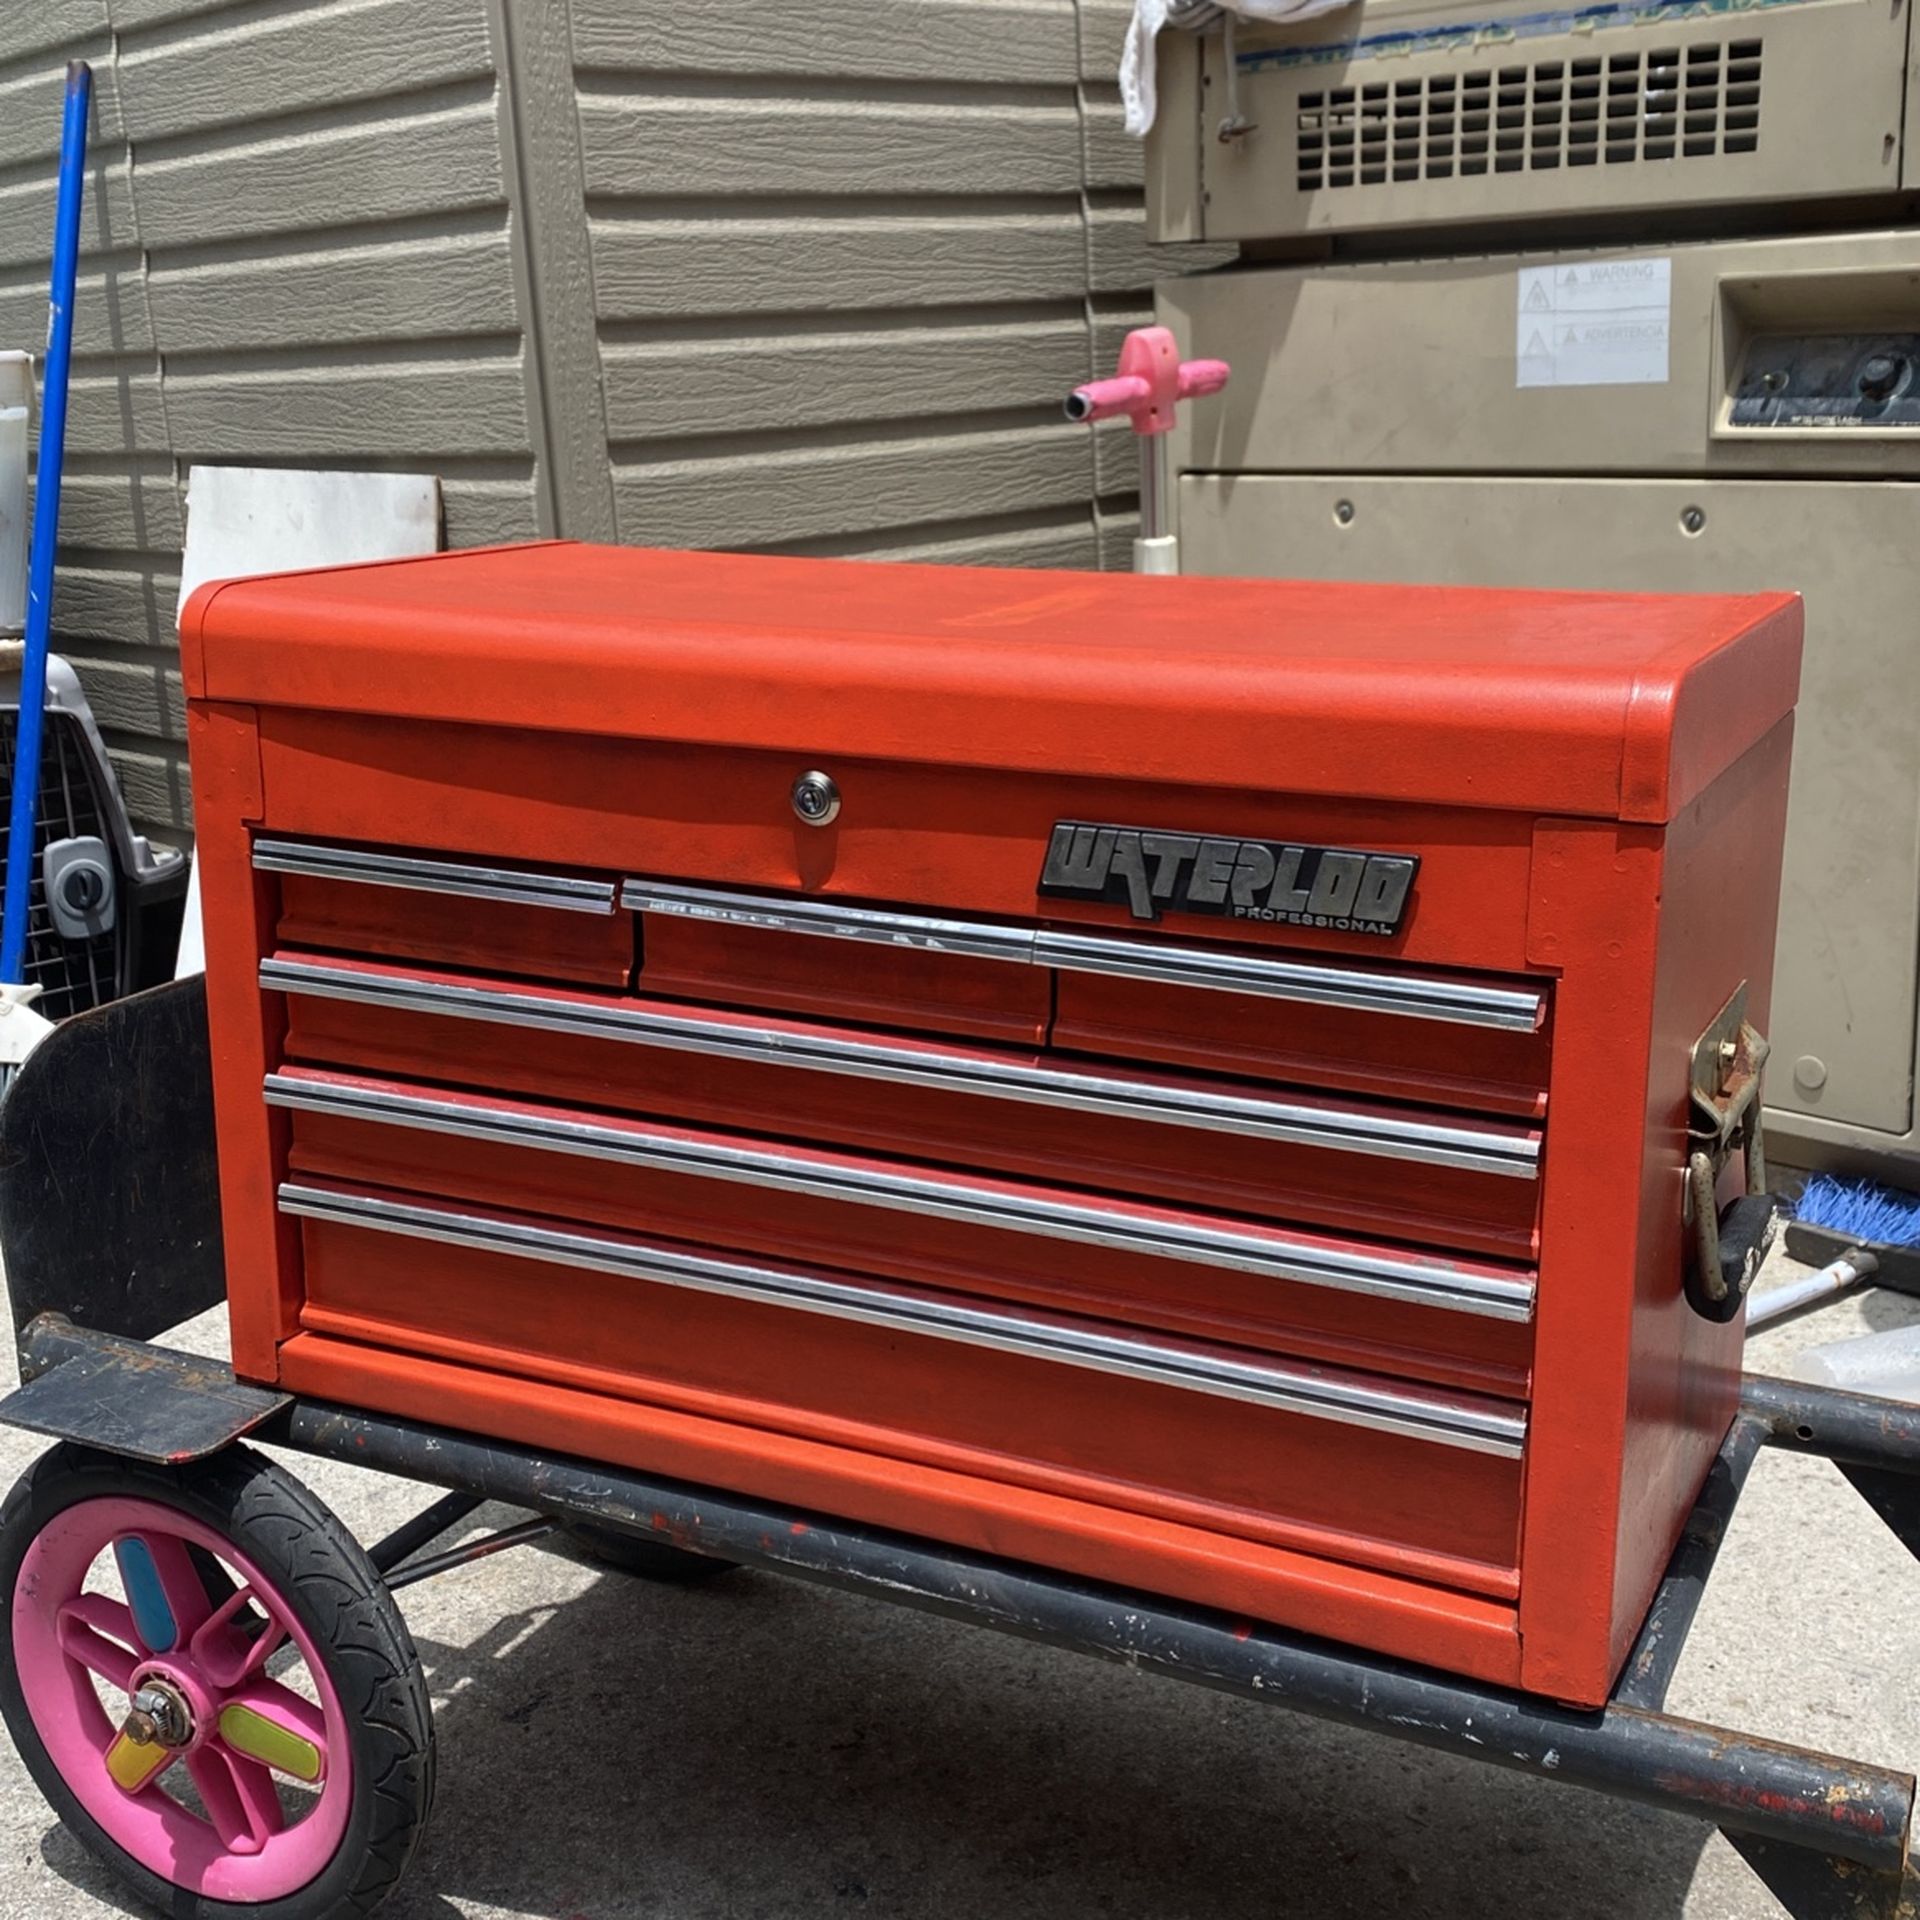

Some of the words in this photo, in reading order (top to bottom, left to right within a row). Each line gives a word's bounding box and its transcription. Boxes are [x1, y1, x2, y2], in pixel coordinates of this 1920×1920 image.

[1589, 264, 1653, 281] WARNING
[1042, 825, 1413, 923] WATERLOO
[1234, 906, 1392, 935] PROFESSIONAL
